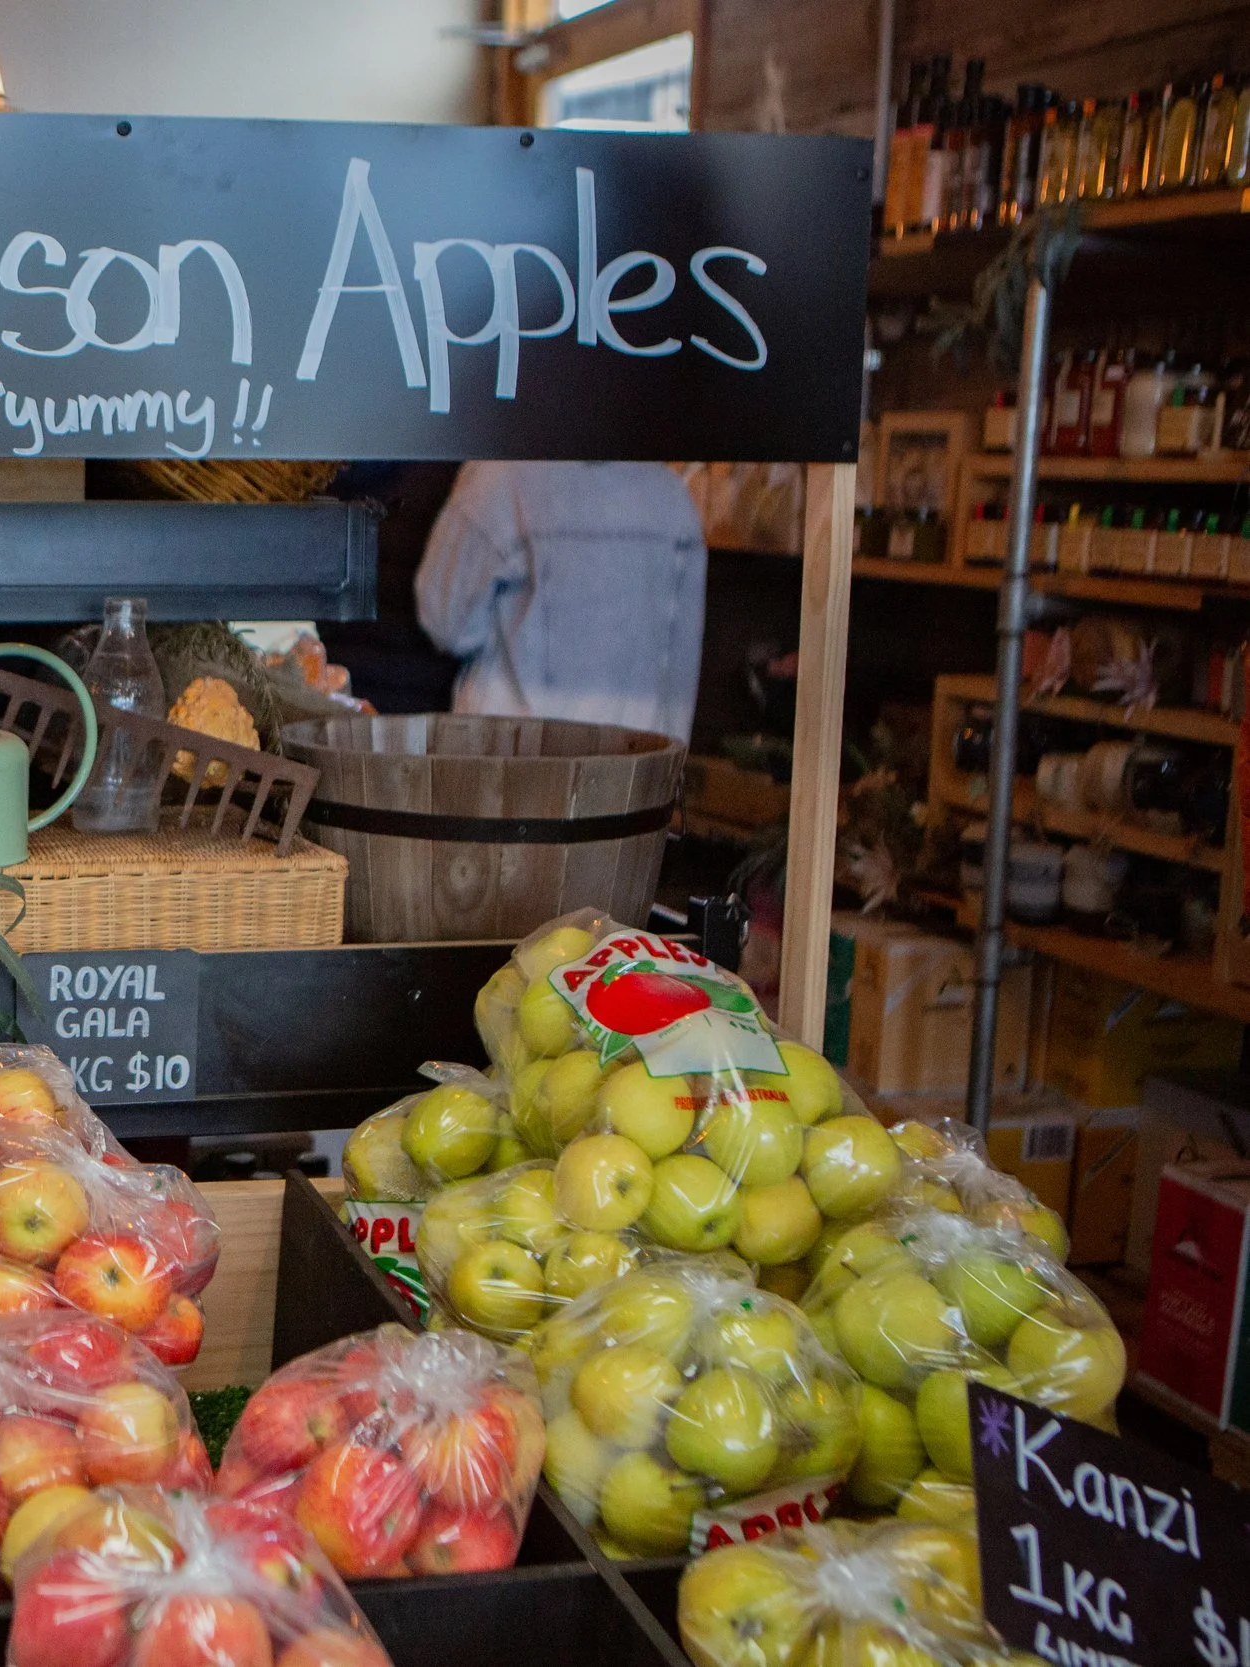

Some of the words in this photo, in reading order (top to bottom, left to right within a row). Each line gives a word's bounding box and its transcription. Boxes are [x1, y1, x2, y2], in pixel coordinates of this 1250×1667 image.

[296, 157, 768, 414] Apples
[50, 964, 166, 1002] ROYAL
[55, 1006, 151, 1039] GALA
[125, 1050, 191, 1094] $10
[1013, 1404, 1202, 1560] Kanzi
[706, 1480, 842, 1552] APPL
